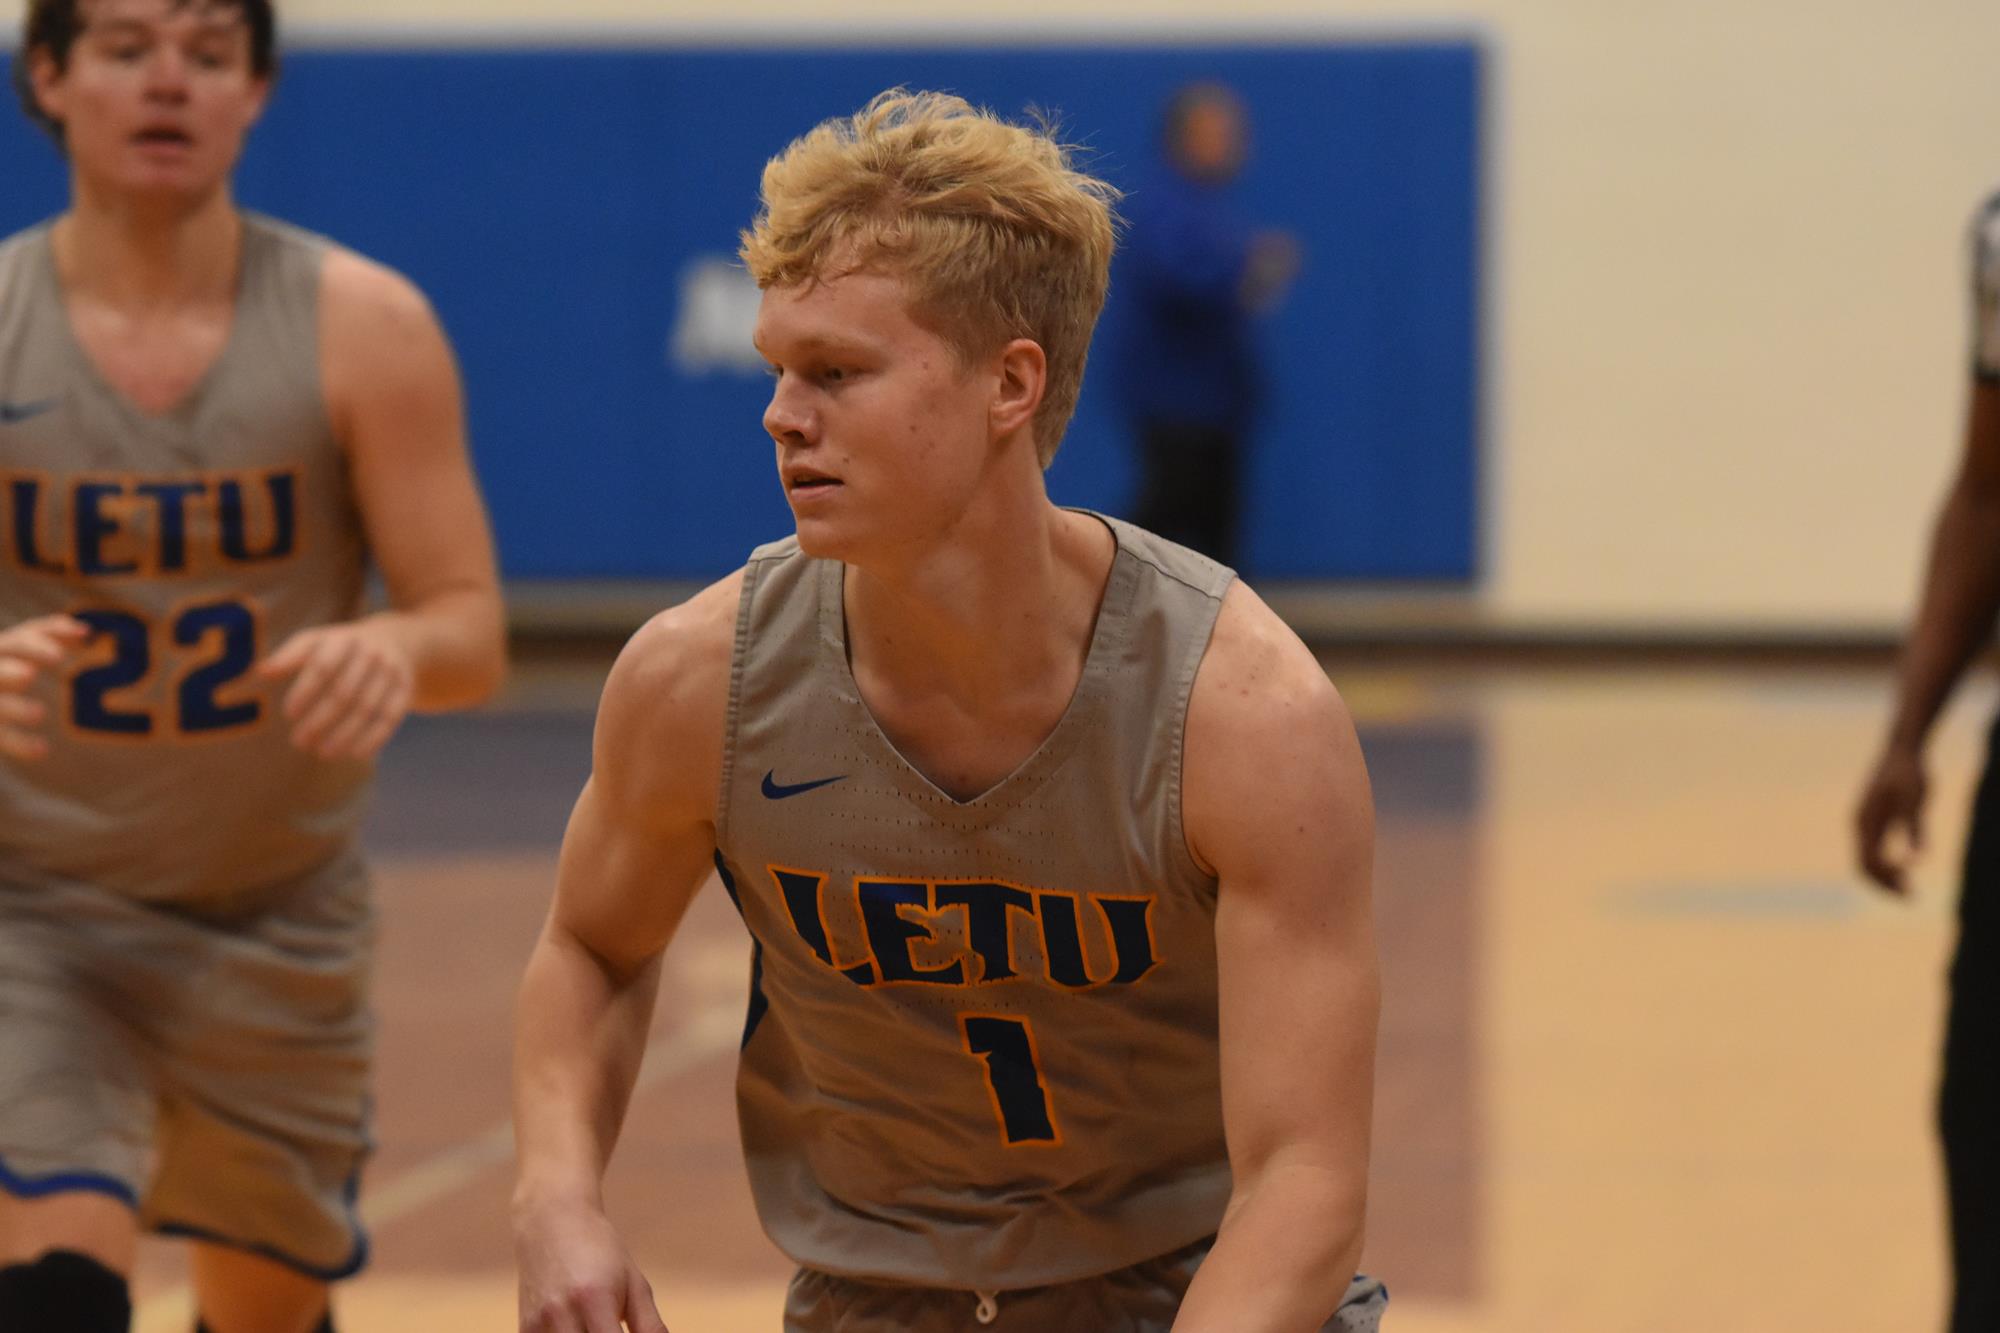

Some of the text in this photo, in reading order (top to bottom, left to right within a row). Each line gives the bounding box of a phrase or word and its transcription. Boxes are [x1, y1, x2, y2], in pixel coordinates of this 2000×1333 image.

[6, 468, 301, 580] LETU
[68, 595, 264, 738] 22
[767, 864, 1164, 992] LETU
[957, 1011, 1062, 1148] 1
